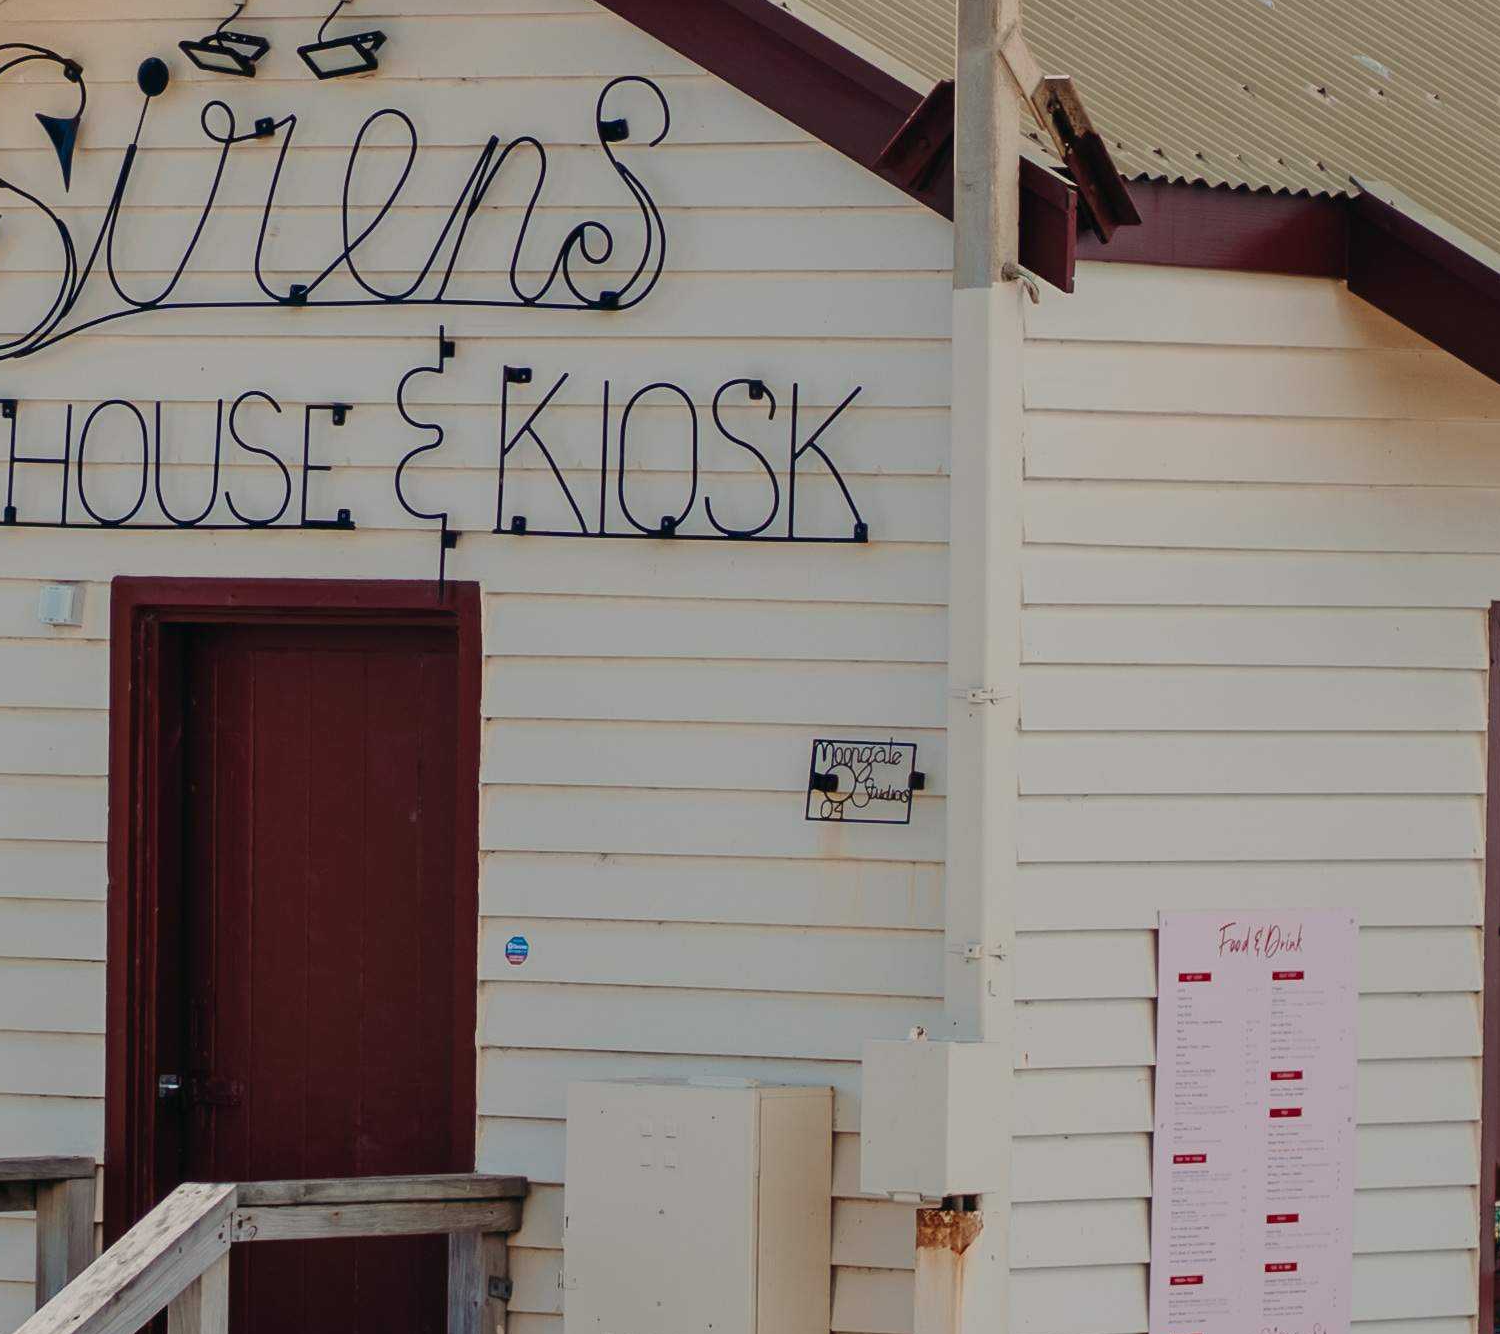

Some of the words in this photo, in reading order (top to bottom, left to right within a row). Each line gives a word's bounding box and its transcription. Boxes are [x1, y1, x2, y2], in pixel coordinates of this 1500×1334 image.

[395, 324, 457, 605] &
[492, 365, 869, 543] KIOSK
[1218, 922, 1251, 957] Food
[1254, 926, 1264, 957] &
[1264, 923, 1303, 958] Drink
